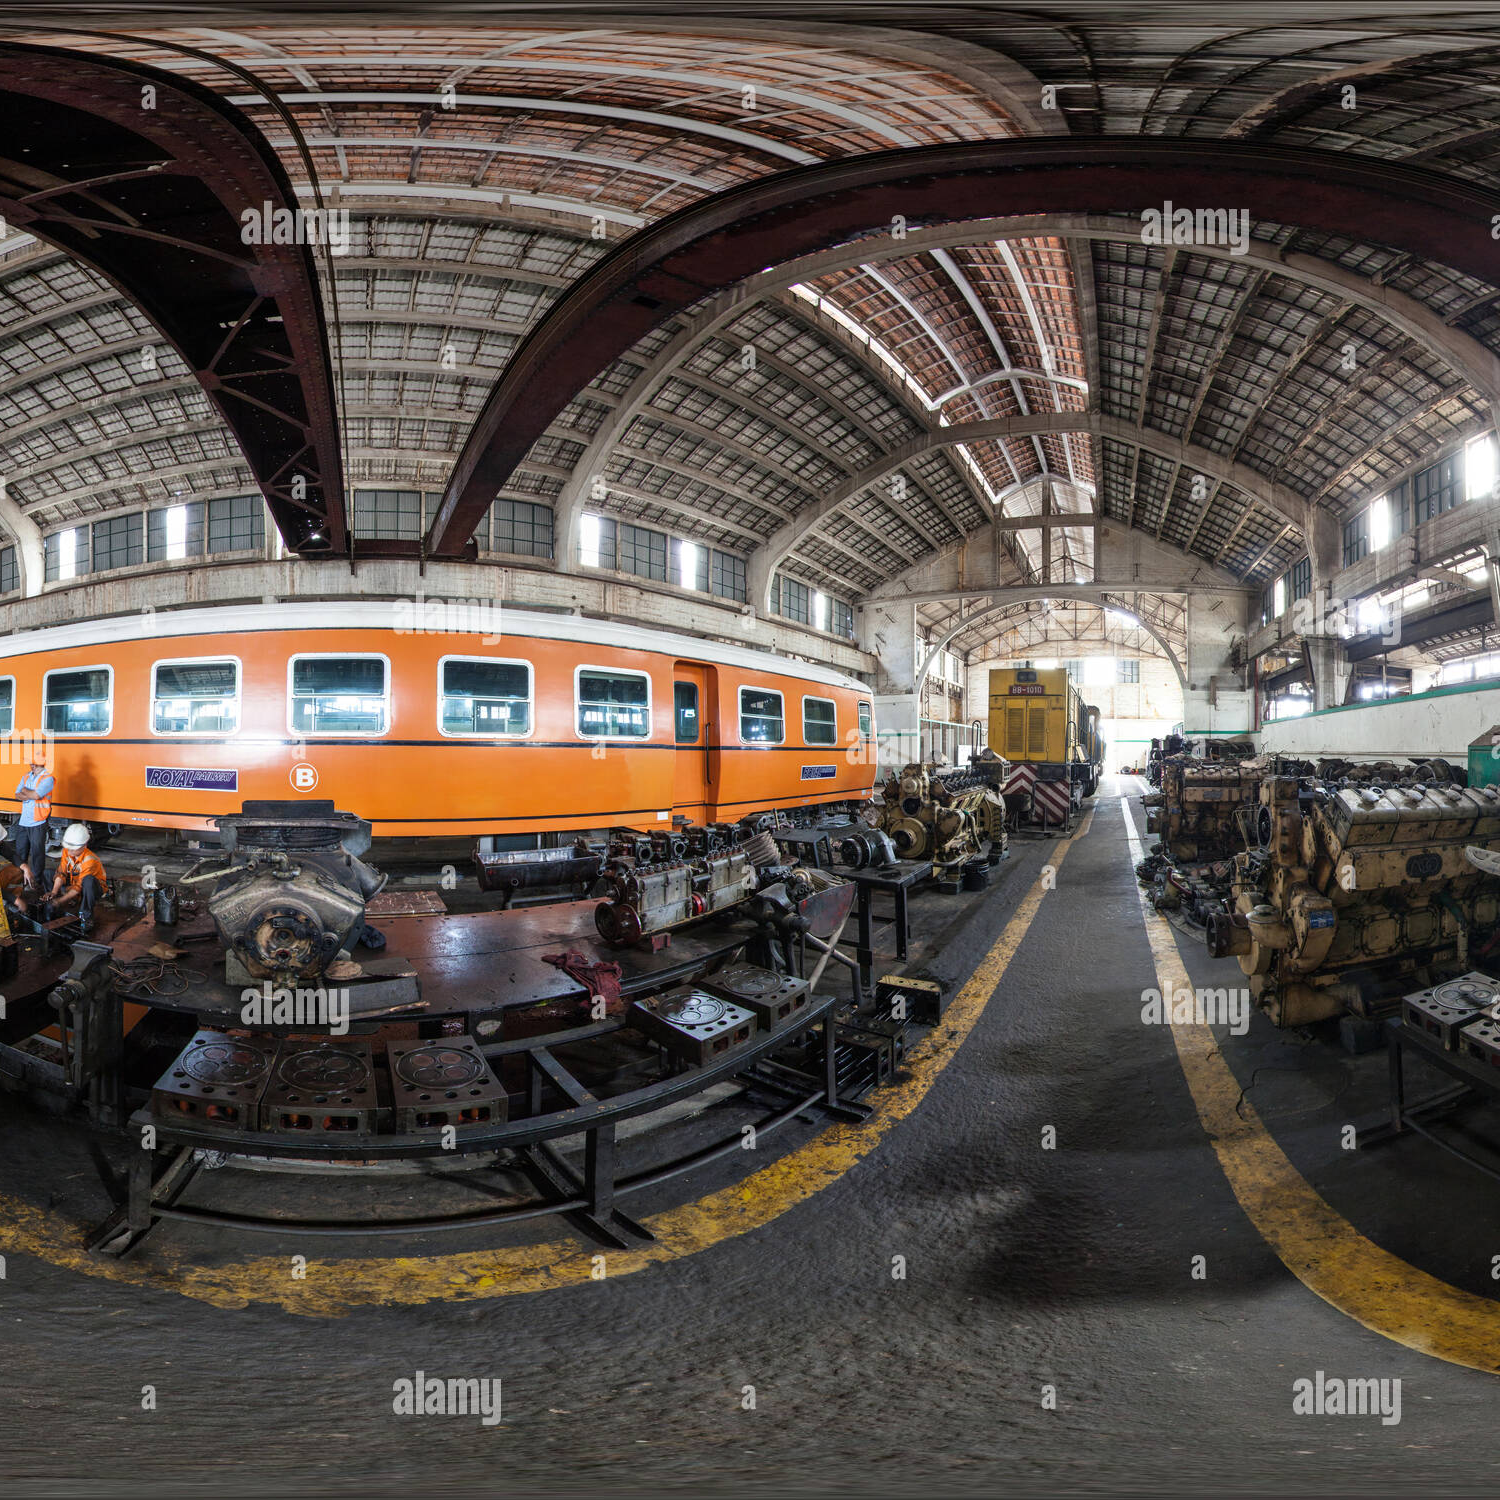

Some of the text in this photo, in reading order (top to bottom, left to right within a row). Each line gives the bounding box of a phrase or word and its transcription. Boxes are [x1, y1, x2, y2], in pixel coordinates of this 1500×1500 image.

[149, 769, 235, 787] ROYAL RAILWAY
[295, 768, 314, 787] B
